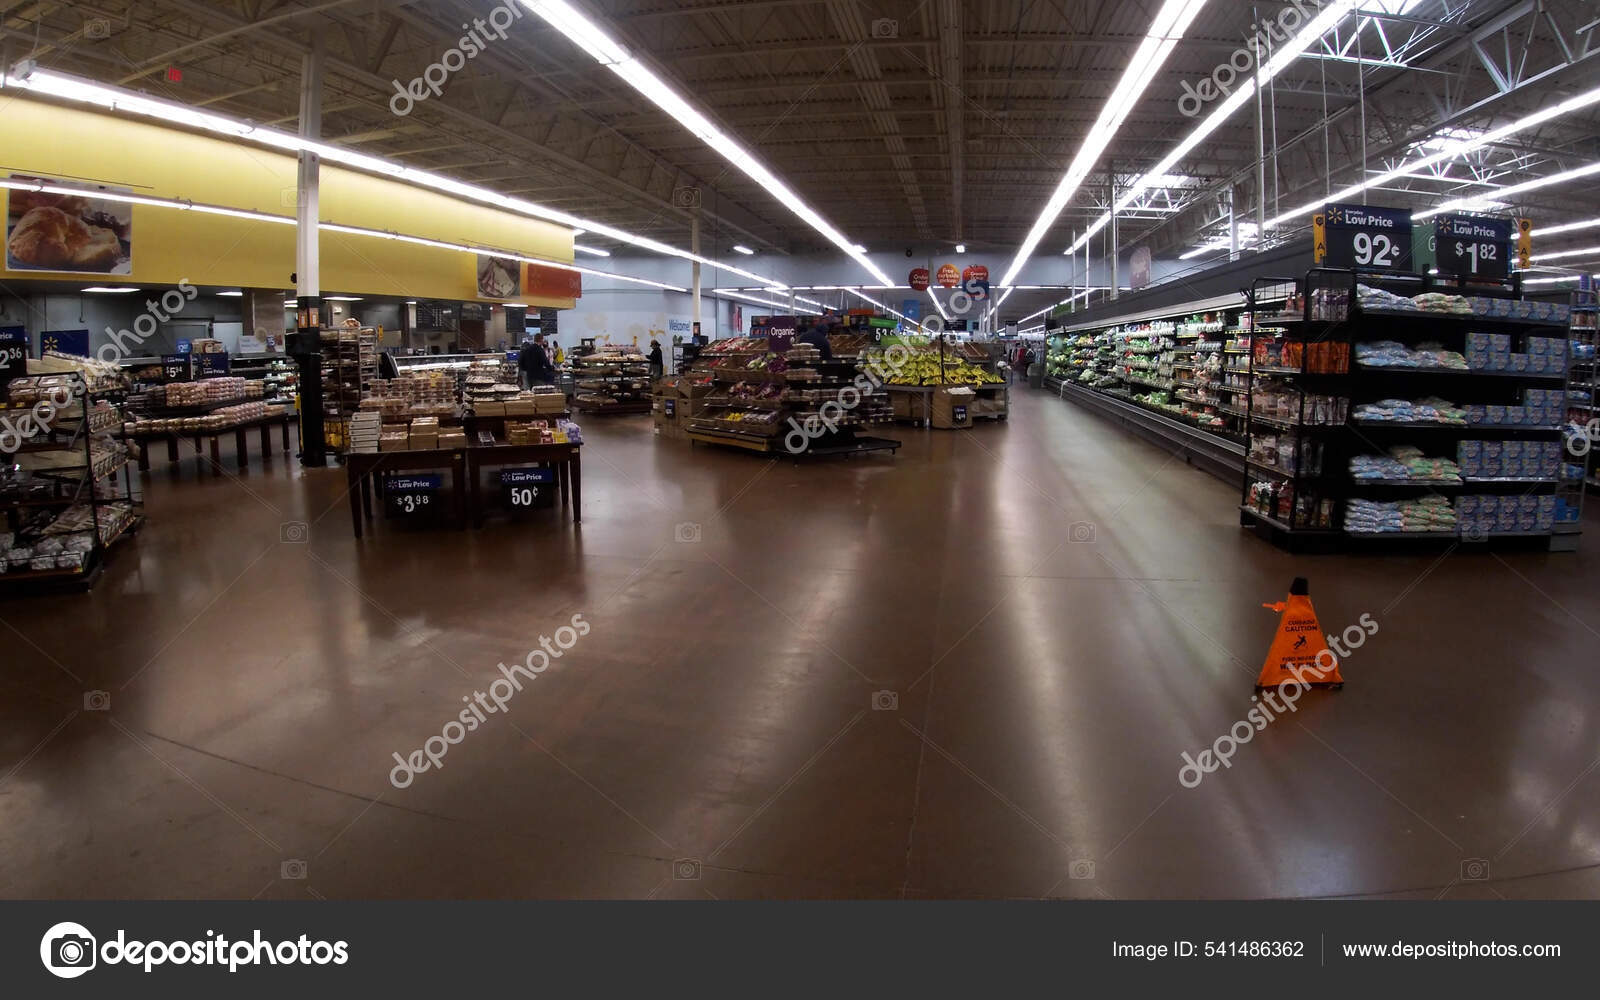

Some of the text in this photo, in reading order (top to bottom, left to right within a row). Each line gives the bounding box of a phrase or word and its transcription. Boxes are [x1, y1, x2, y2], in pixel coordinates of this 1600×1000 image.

[1345, 214, 1393, 228] Low Price
[1453, 224, 1496, 238] Low Price
[770, 326, 795, 338] Organic
[413, 480, 430, 488] Price
